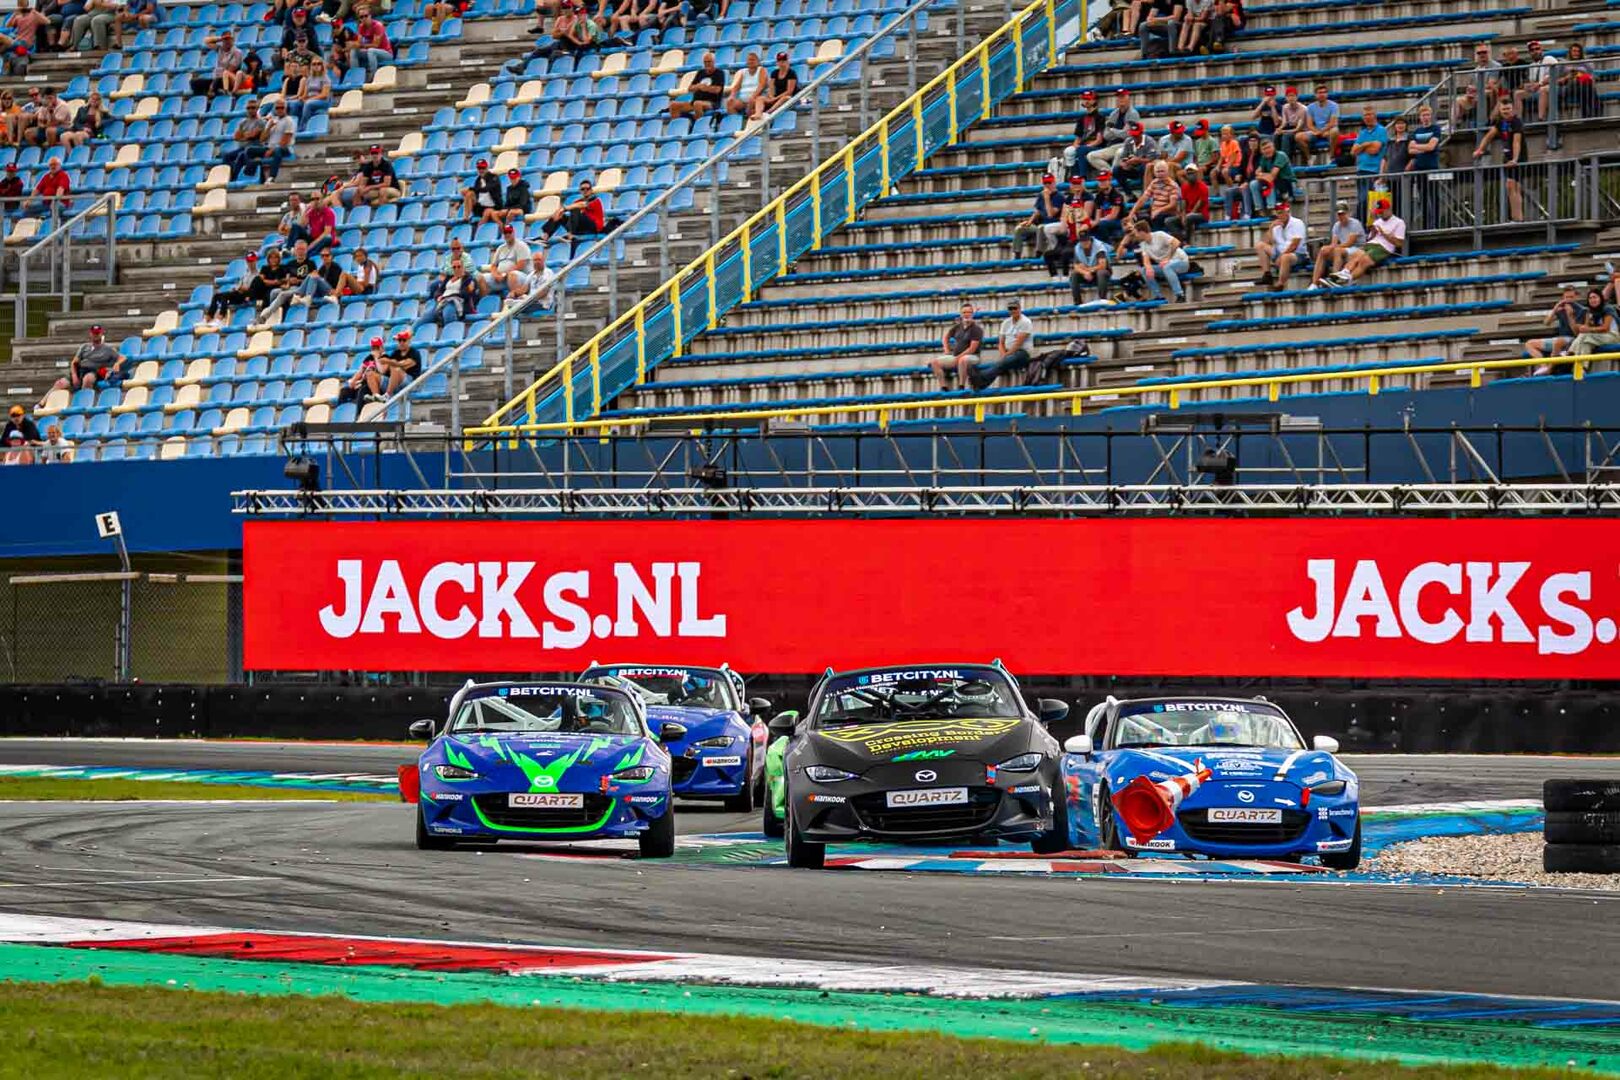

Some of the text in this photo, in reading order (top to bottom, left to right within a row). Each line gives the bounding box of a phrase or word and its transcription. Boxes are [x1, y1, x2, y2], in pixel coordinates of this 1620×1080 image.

[102, 515, 116, 534] E
[1286, 559, 1620, 655] JACKS.
[617, 668, 691, 679] BETCITY.NL
[871, 670, 965, 684] BETCITY.NL
[510, 687, 595, 697] BETCITY.NL
[1164, 702, 1250, 714] BETCITY.NL
[864, 731, 940, 747] Crossing
[867, 735, 984, 753] Development
[513, 795, 579, 806] QUARTZ
[892, 790, 963, 804] QUARTZ
[1213, 810, 1278, 821] QUARTZ
